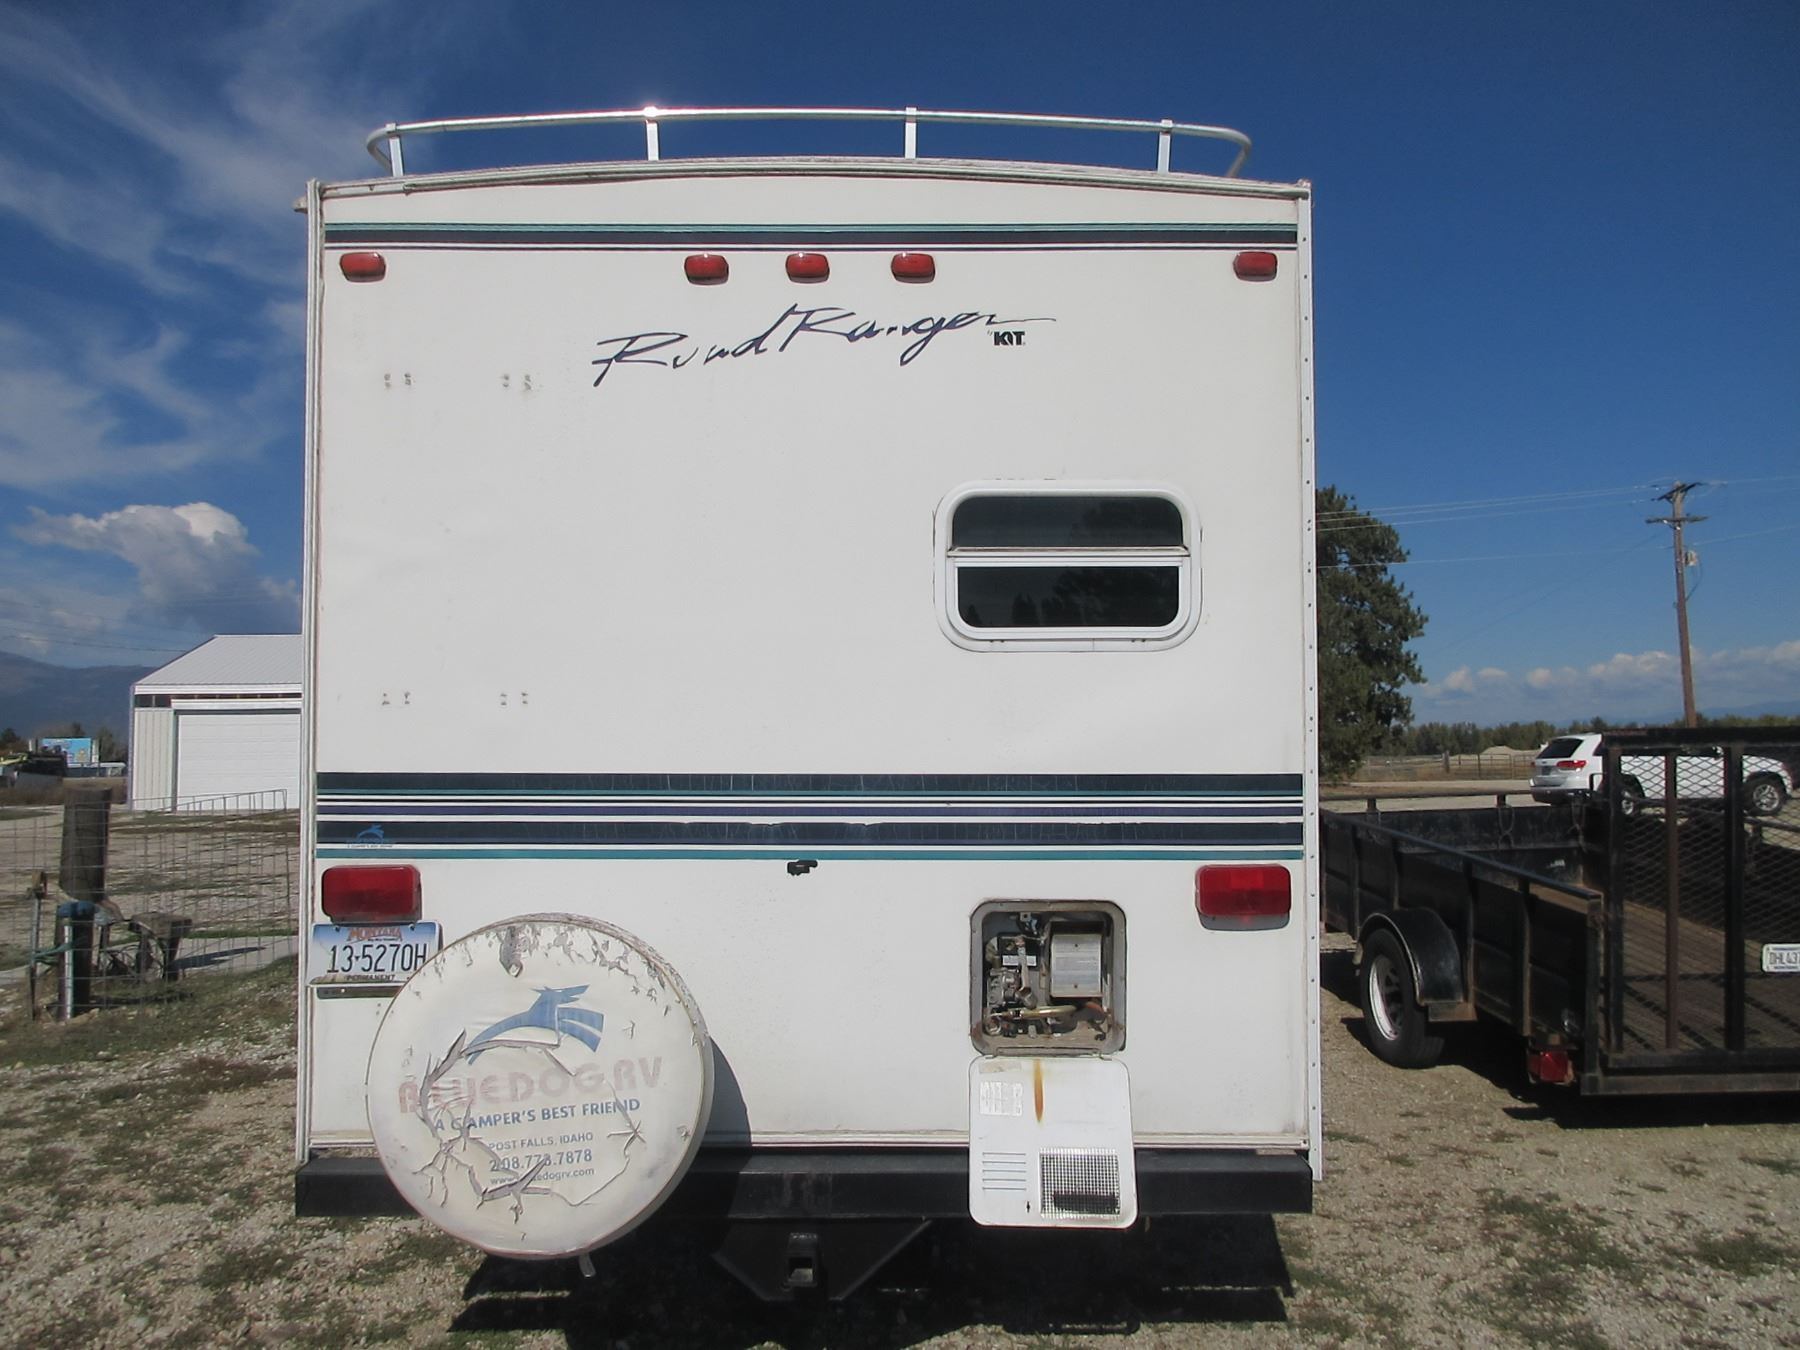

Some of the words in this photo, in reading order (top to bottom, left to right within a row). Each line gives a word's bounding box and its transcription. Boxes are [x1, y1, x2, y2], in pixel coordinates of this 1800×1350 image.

[613, 1056, 662, 1091] RV
[541, 1104, 577, 1121] BEST
[582, 1098, 641, 1117] FRIEND
[559, 1131, 594, 1145] IDAHO
